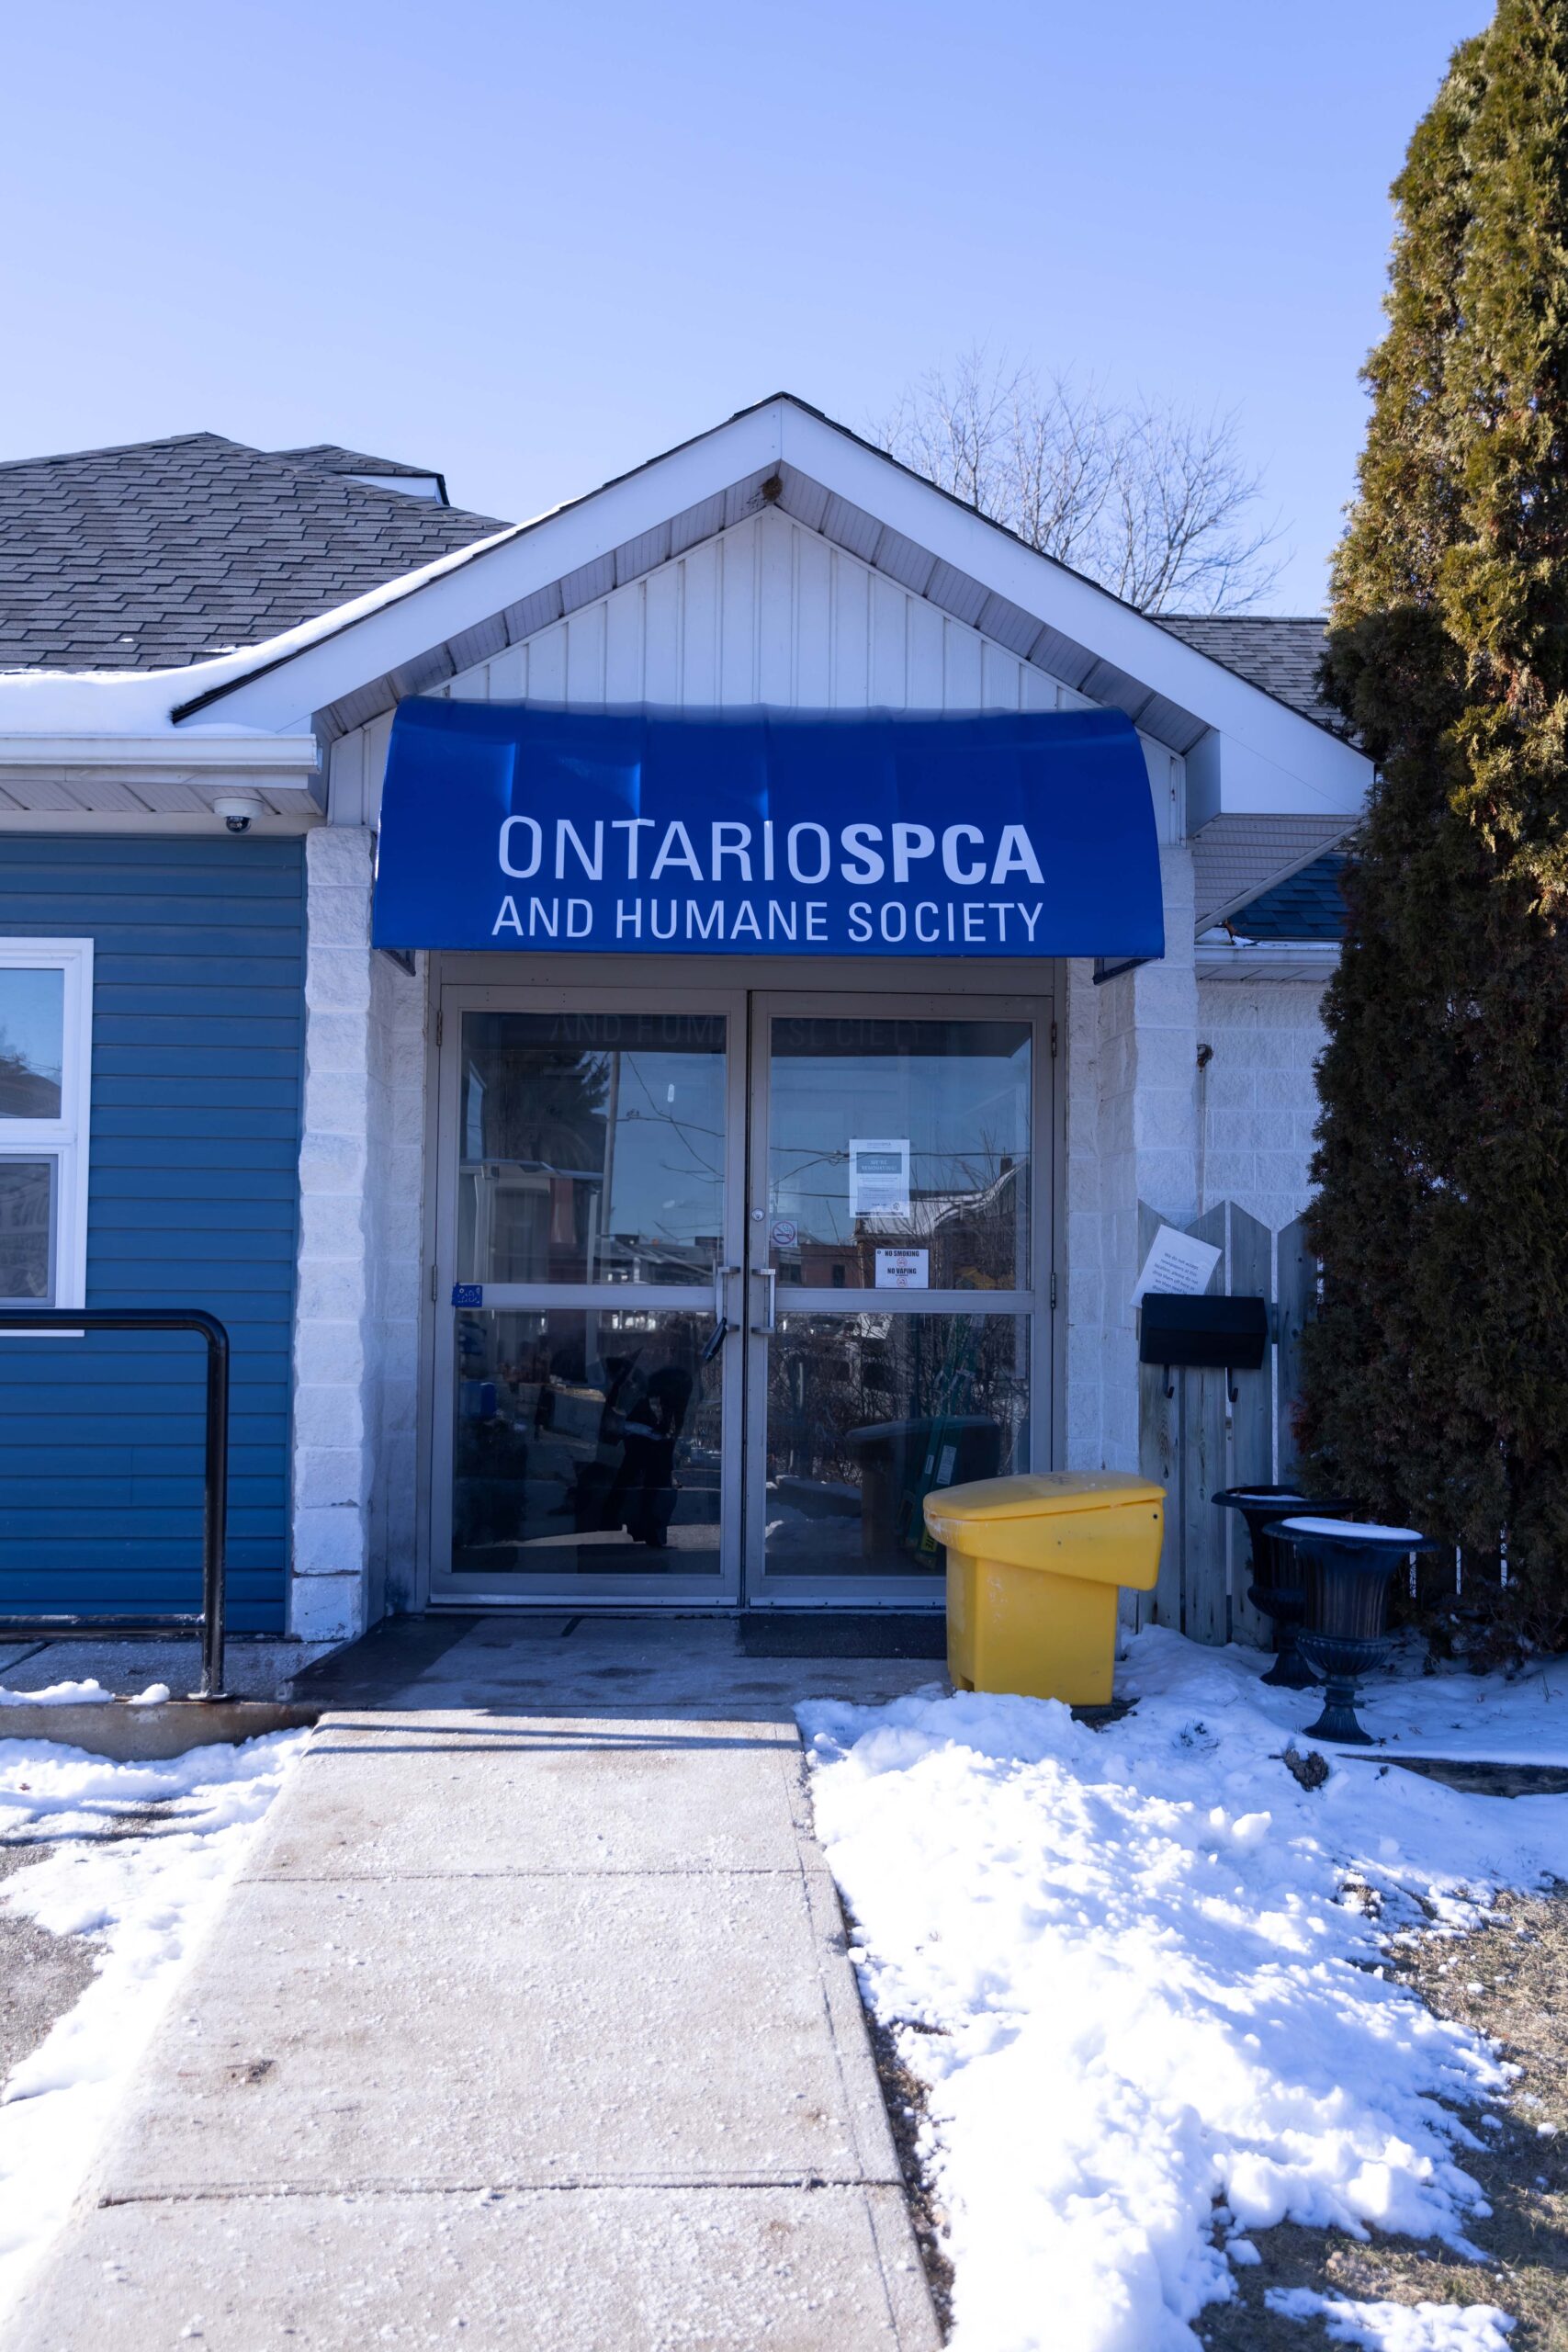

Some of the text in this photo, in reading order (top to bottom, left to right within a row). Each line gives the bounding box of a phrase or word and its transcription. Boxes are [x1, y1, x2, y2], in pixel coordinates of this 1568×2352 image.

[491, 895, 1043, 943] AND HUMANE SOCIETY
